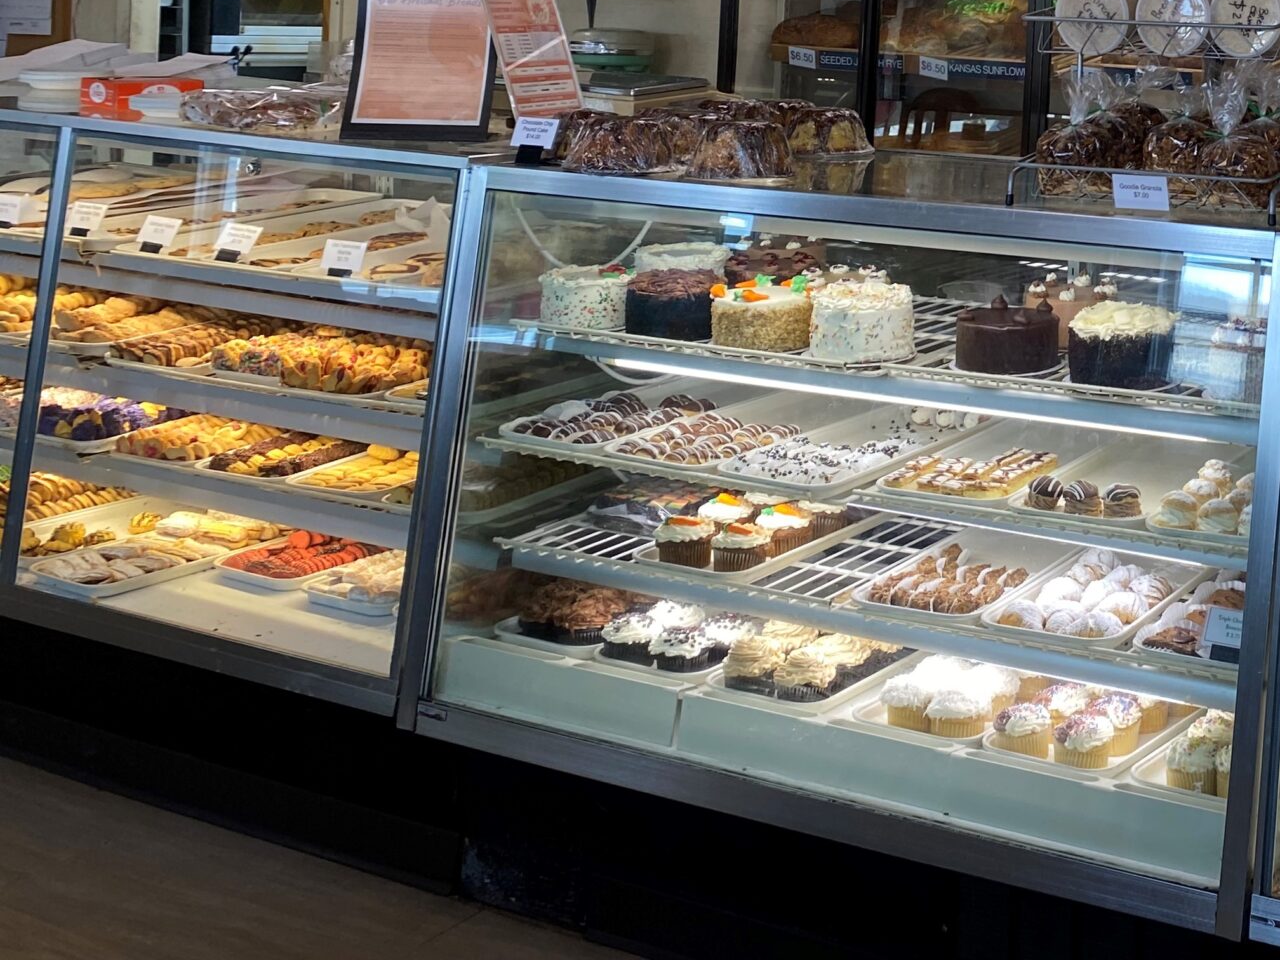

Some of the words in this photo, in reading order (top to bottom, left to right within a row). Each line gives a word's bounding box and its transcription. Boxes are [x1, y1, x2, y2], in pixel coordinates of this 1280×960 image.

[790, 50, 814, 64] $6.50
[820, 55, 853, 67] SEEDED
[921, 60, 946, 75] $6.50
[948, 63, 981, 75] KANSAS
